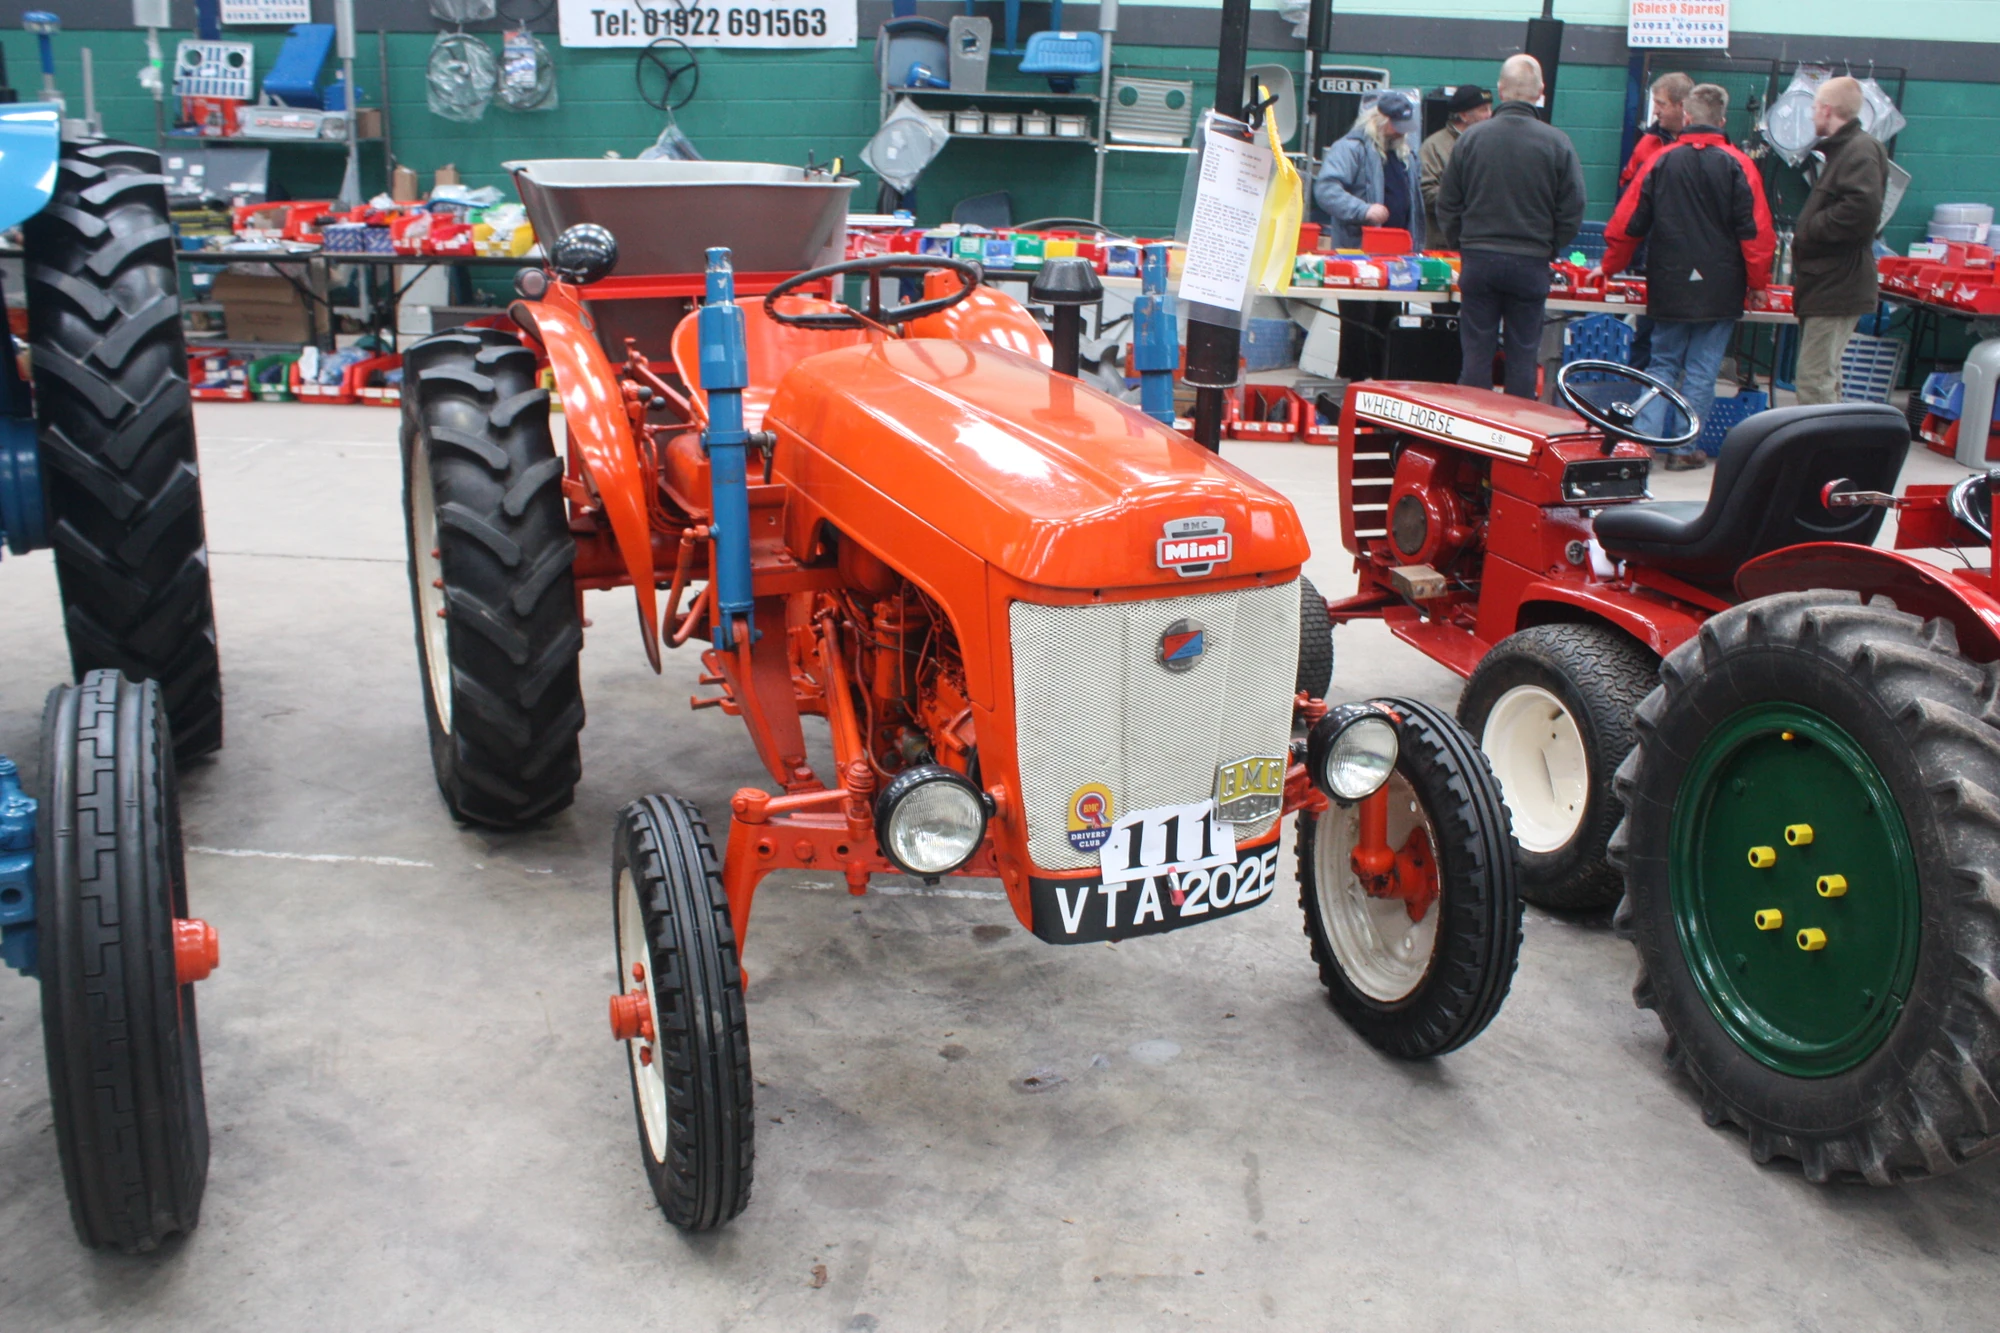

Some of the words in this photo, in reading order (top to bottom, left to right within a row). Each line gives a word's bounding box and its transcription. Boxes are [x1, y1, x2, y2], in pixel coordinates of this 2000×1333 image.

[1669, 3, 1677, 14] &
[590, 9, 637, 36] Tel:
[643, 8, 720, 36] 01922
[727, 8, 827, 36] 691563
[1633, 22, 1671, 30] 01922
[1677, 22, 1724, 31] 691563
[1632, 36, 1671, 44] 01922
[1676, 36, 1724, 45] 691896
[1362, 394, 1404, 421] WHEEL
[1408, 405, 1455, 435] HORSE
[1183, 521, 1208, 531] BMC
[1165, 539, 1226, 561] Mini
[1222, 761, 1280, 797] BMC
[1083, 803, 1099, 813] BMC
[1079, 840, 1101, 848] CLUB
[1120, 808, 1219, 871] 111
[1055, 876, 1164, 934] VTA
[1180, 846, 1278, 917] 202E
